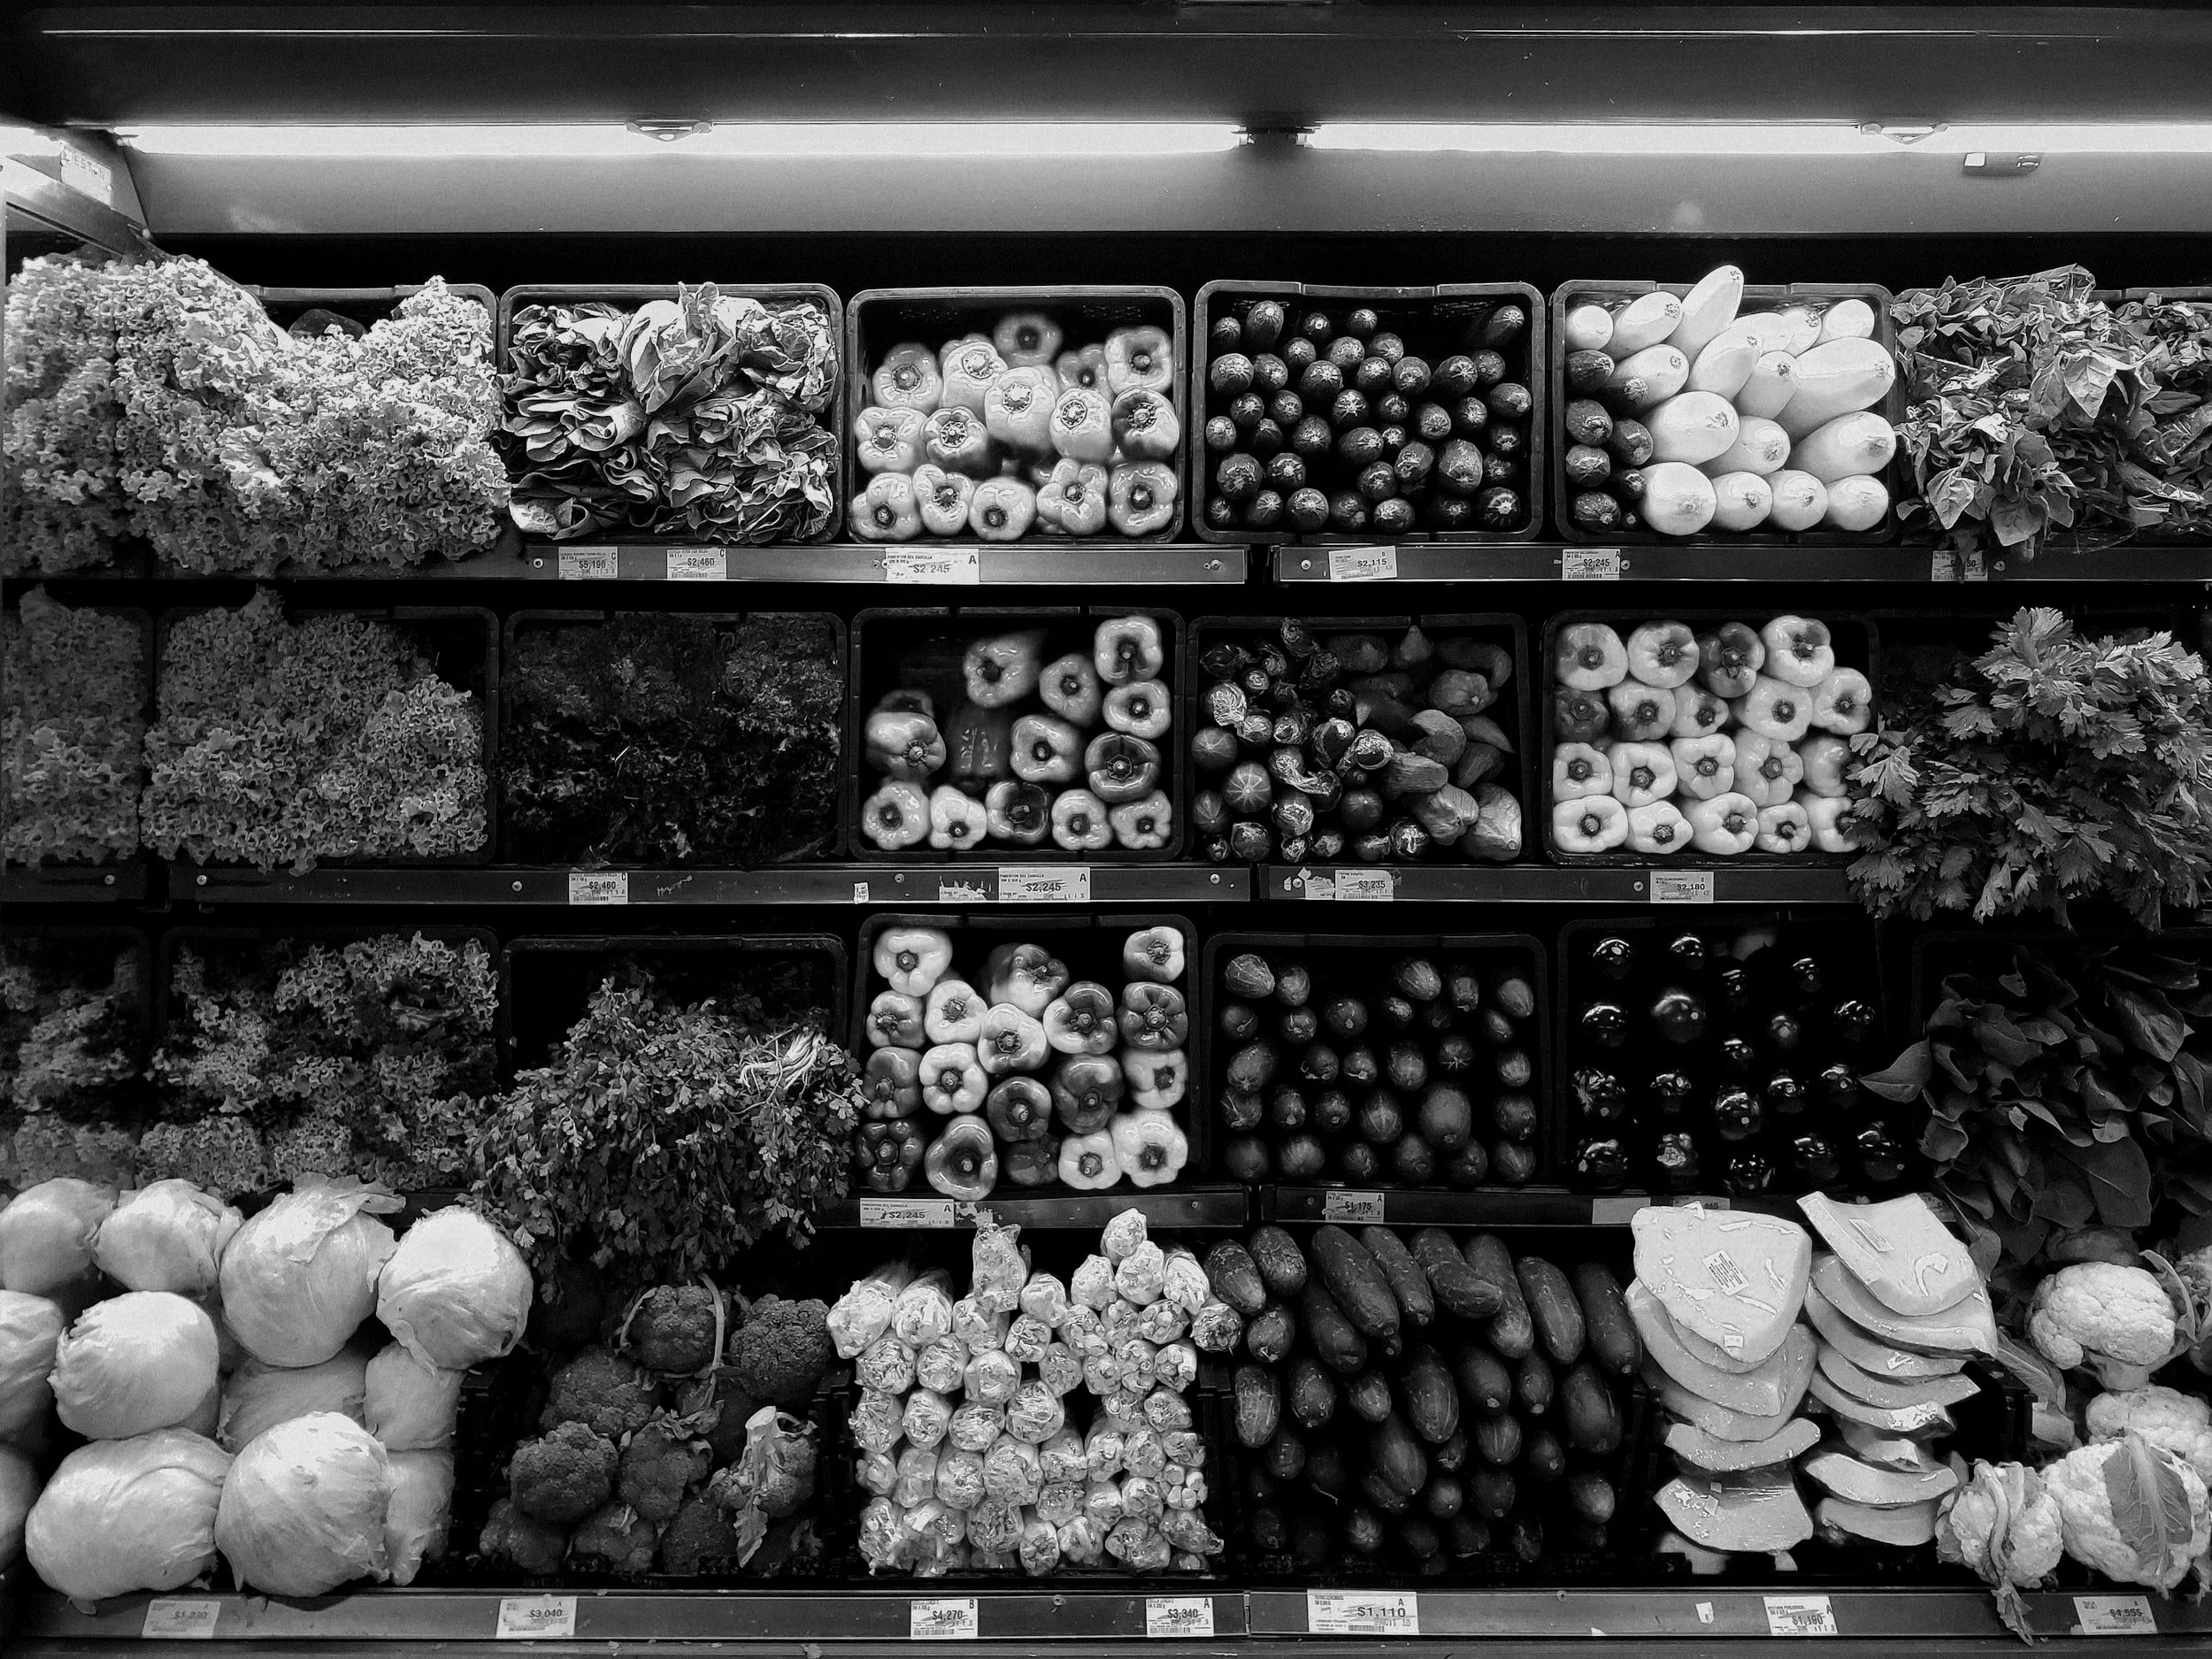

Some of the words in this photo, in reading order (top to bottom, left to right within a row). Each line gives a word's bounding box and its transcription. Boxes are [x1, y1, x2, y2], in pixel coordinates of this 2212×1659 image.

[719, 549, 725, 557] C
[968, 555, 977, 565] A
[1357, 558, 1387, 567] $2,115
[1583, 558, 1610, 568] $2,245
[913, 564, 950, 573] $2245
[621, 872, 626, 881] C
[1079, 873, 1087, 882] A
[588, 881, 617, 891] $2,460
[1025, 882, 1062, 893] $2,245
[1377, 1194, 1382, 1203] A
[888, 1211, 926, 1220] $2,245
[969, 1599, 974, 1609] B
[1203, 1598, 1210, 1609] A
[1397, 1598, 1404, 1607] A
[1356, 1606, 1406, 1618] $1,110
[1792, 1614, 1824, 1627] $1,190
